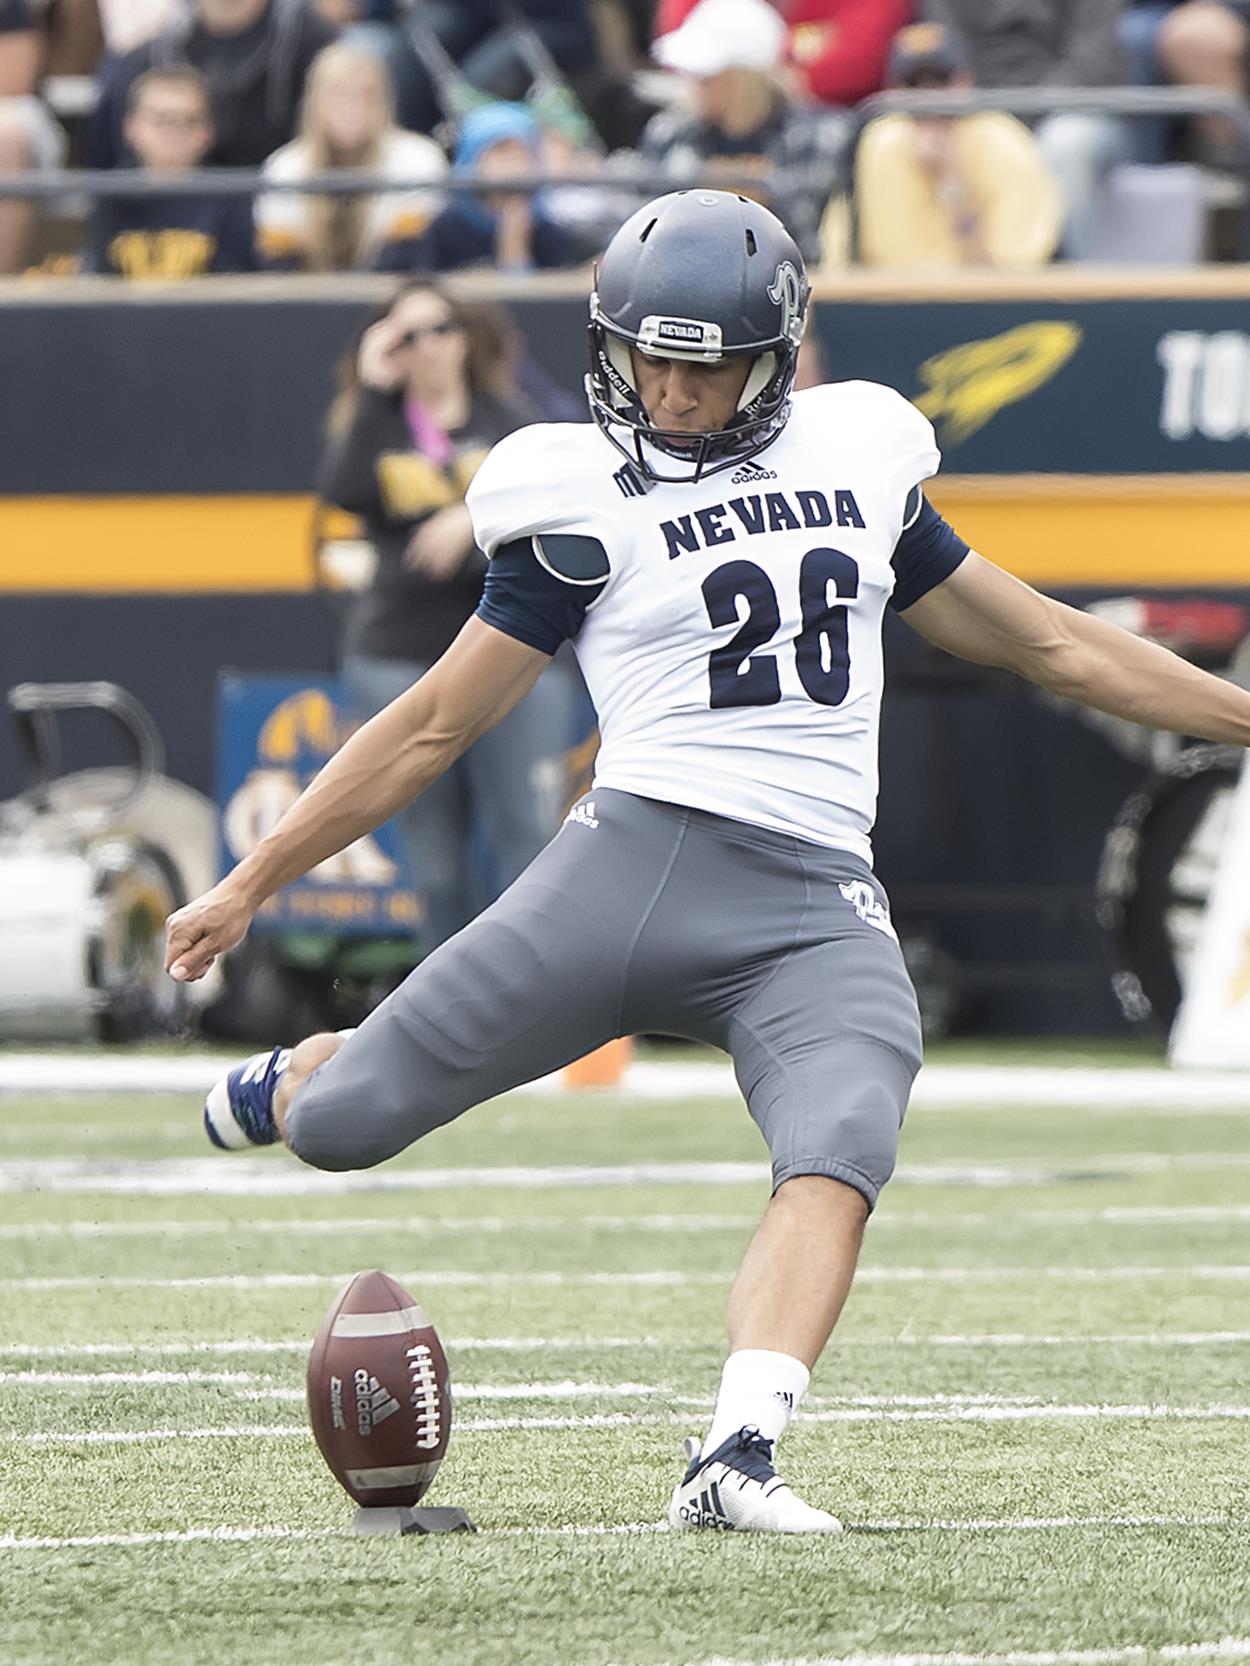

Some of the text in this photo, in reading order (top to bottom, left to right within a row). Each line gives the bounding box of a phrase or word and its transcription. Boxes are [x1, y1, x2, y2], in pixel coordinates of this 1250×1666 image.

[660, 323, 703, 338] NEVADA
[730, 469, 778, 484] adidas
[659, 489, 867, 560] NEVADA
[701, 547, 859, 709] 26
[354, 1368, 372, 1437] adidas
